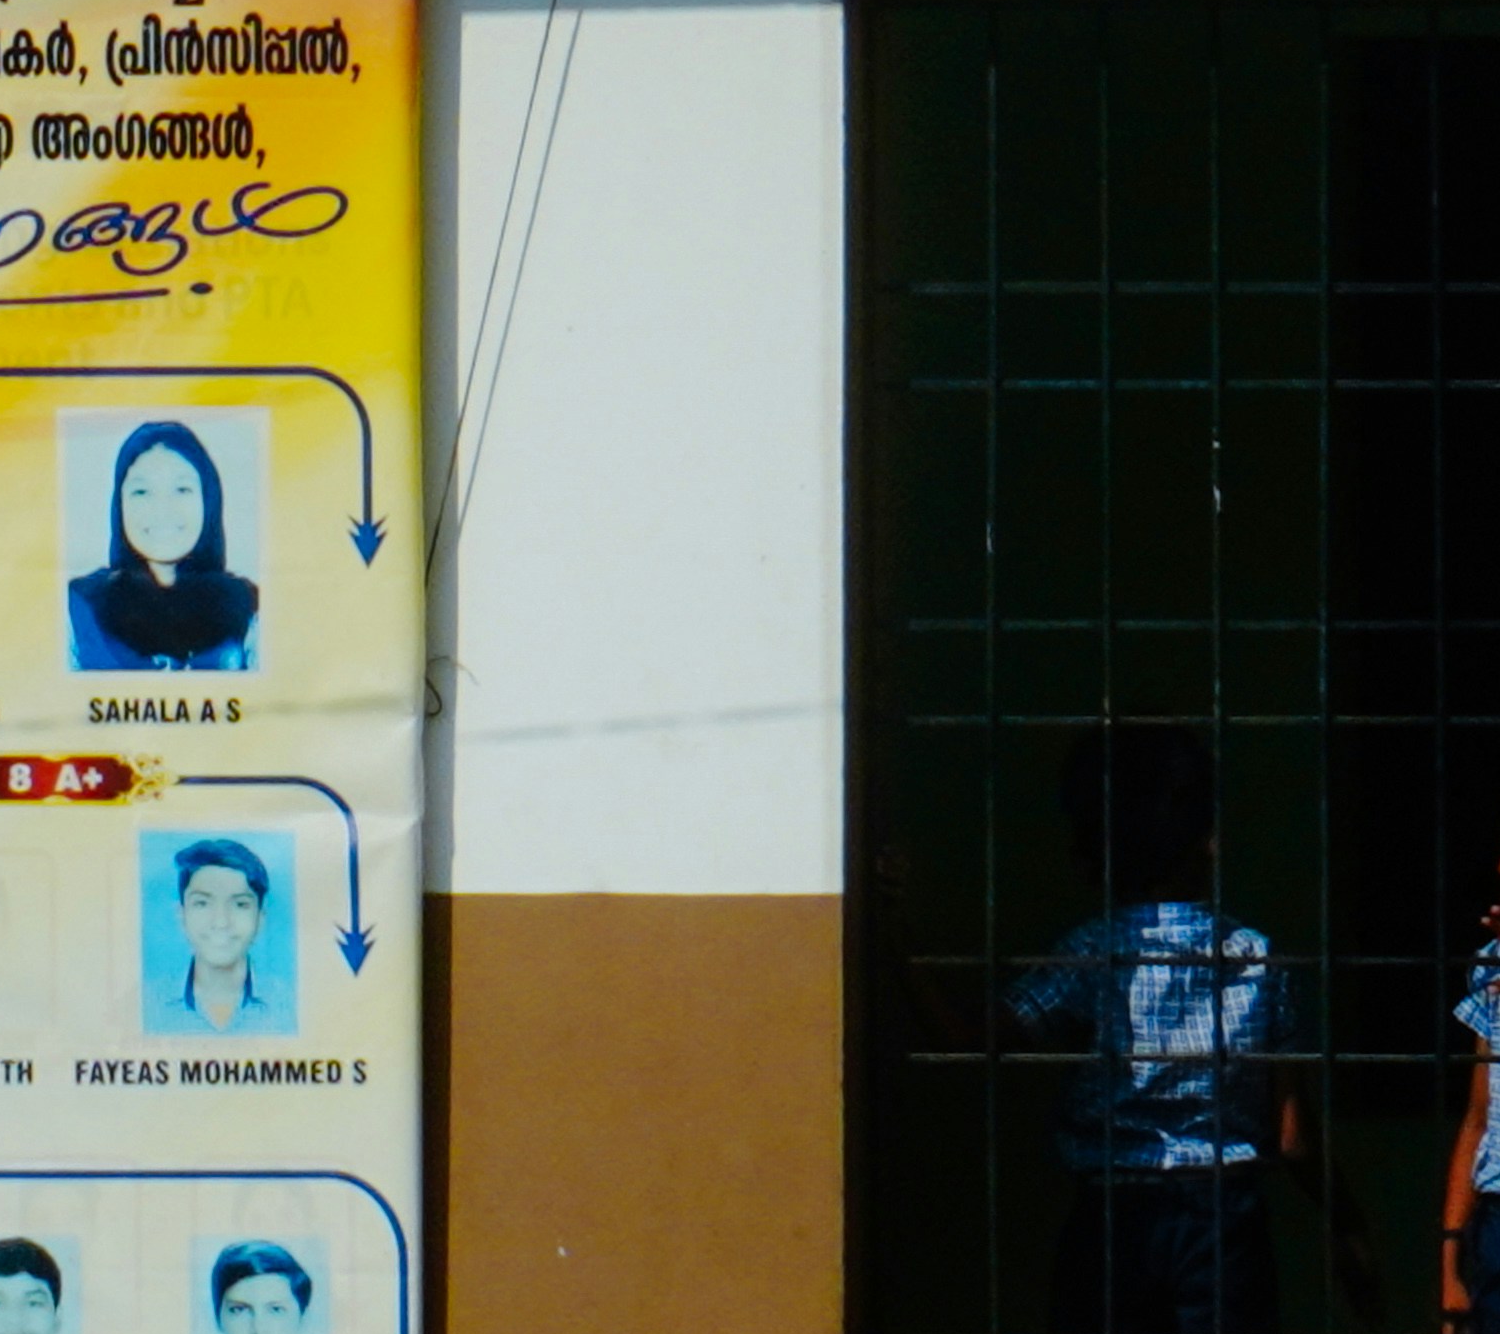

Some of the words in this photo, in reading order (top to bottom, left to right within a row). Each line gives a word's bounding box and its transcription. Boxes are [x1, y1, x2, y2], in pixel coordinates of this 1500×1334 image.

[88, 697, 191, 725] SAHALA
[199, 698, 217, 723] A
[225, 697, 242, 724] S
[8, 762, 31, 794] 8
[55, 762, 102, 794] A+
[74, 1059, 170, 1086] FAYEAS
[180, 1059, 339, 1086] MOHAMMED
[352, 1058, 368, 1086] S
